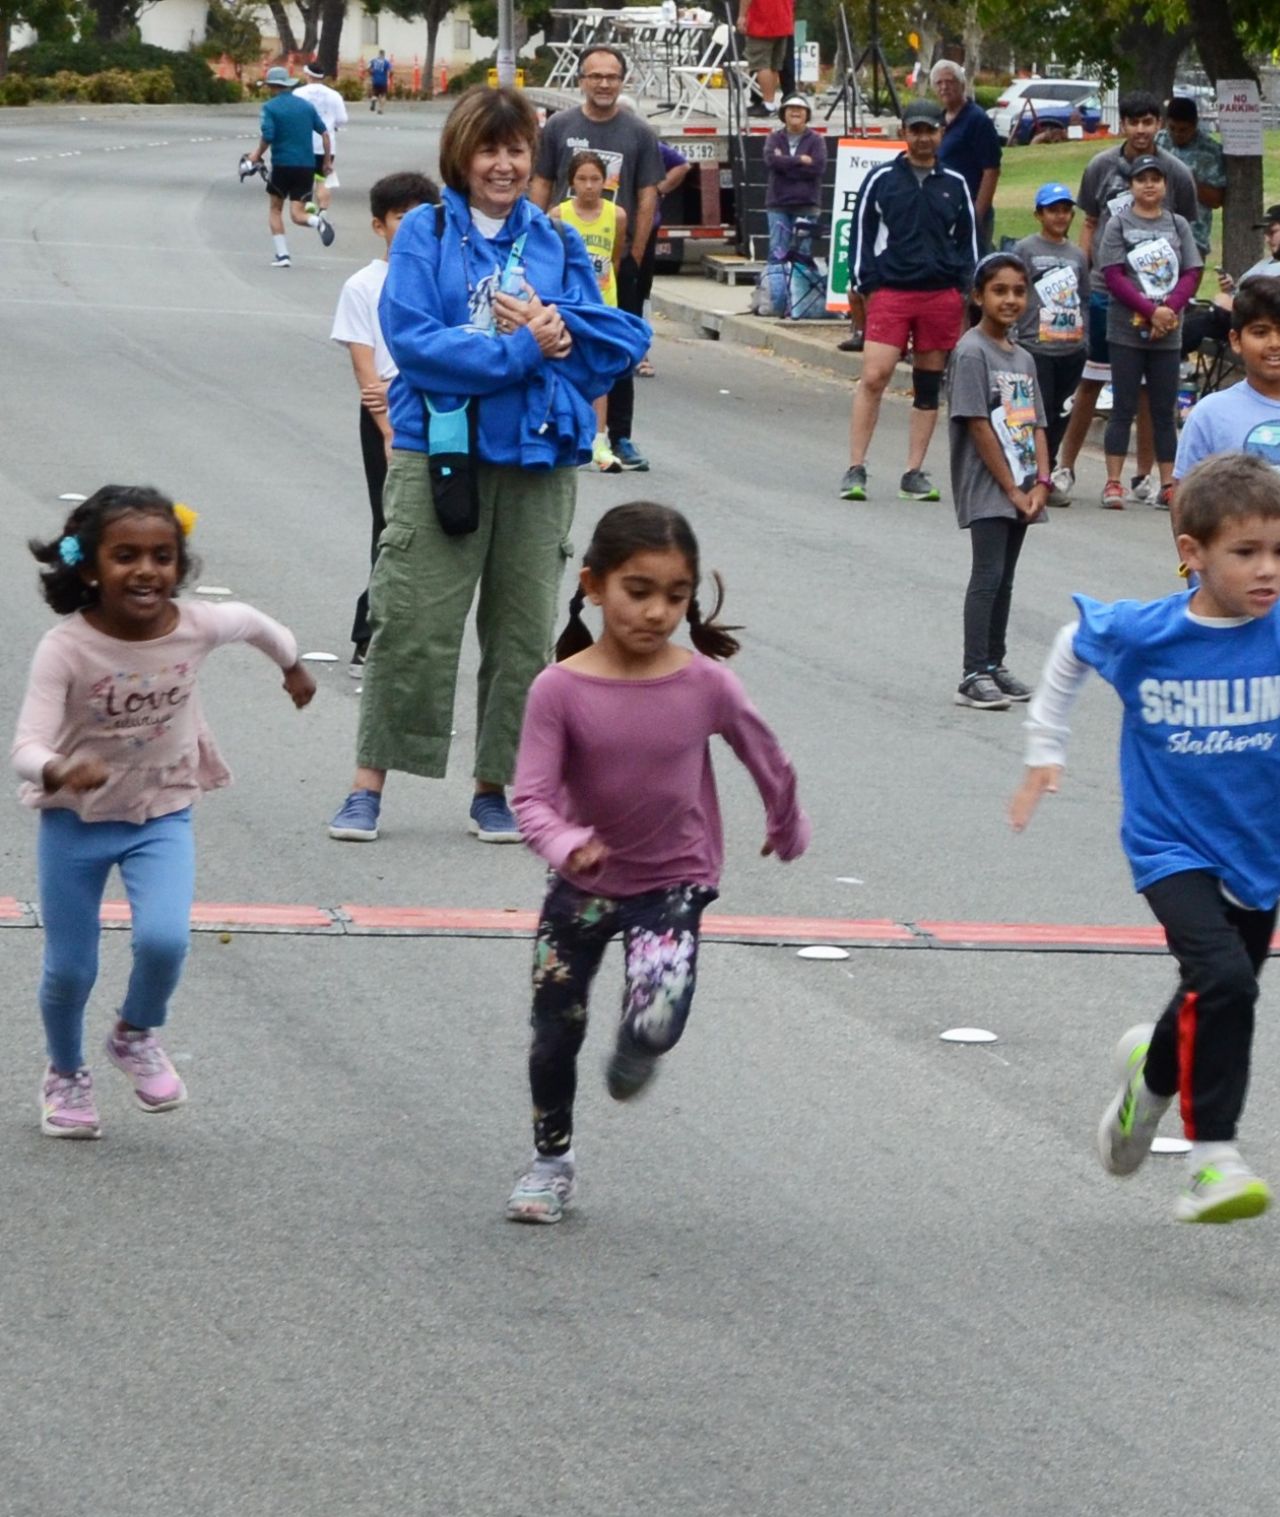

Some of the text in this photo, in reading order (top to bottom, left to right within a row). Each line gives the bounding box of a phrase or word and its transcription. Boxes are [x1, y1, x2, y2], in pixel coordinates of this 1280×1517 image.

[1233, 94, 1248, 103] NO
[1219, 103, 1259, 113] PARKING
[1051, 313, 1077, 327] 730
